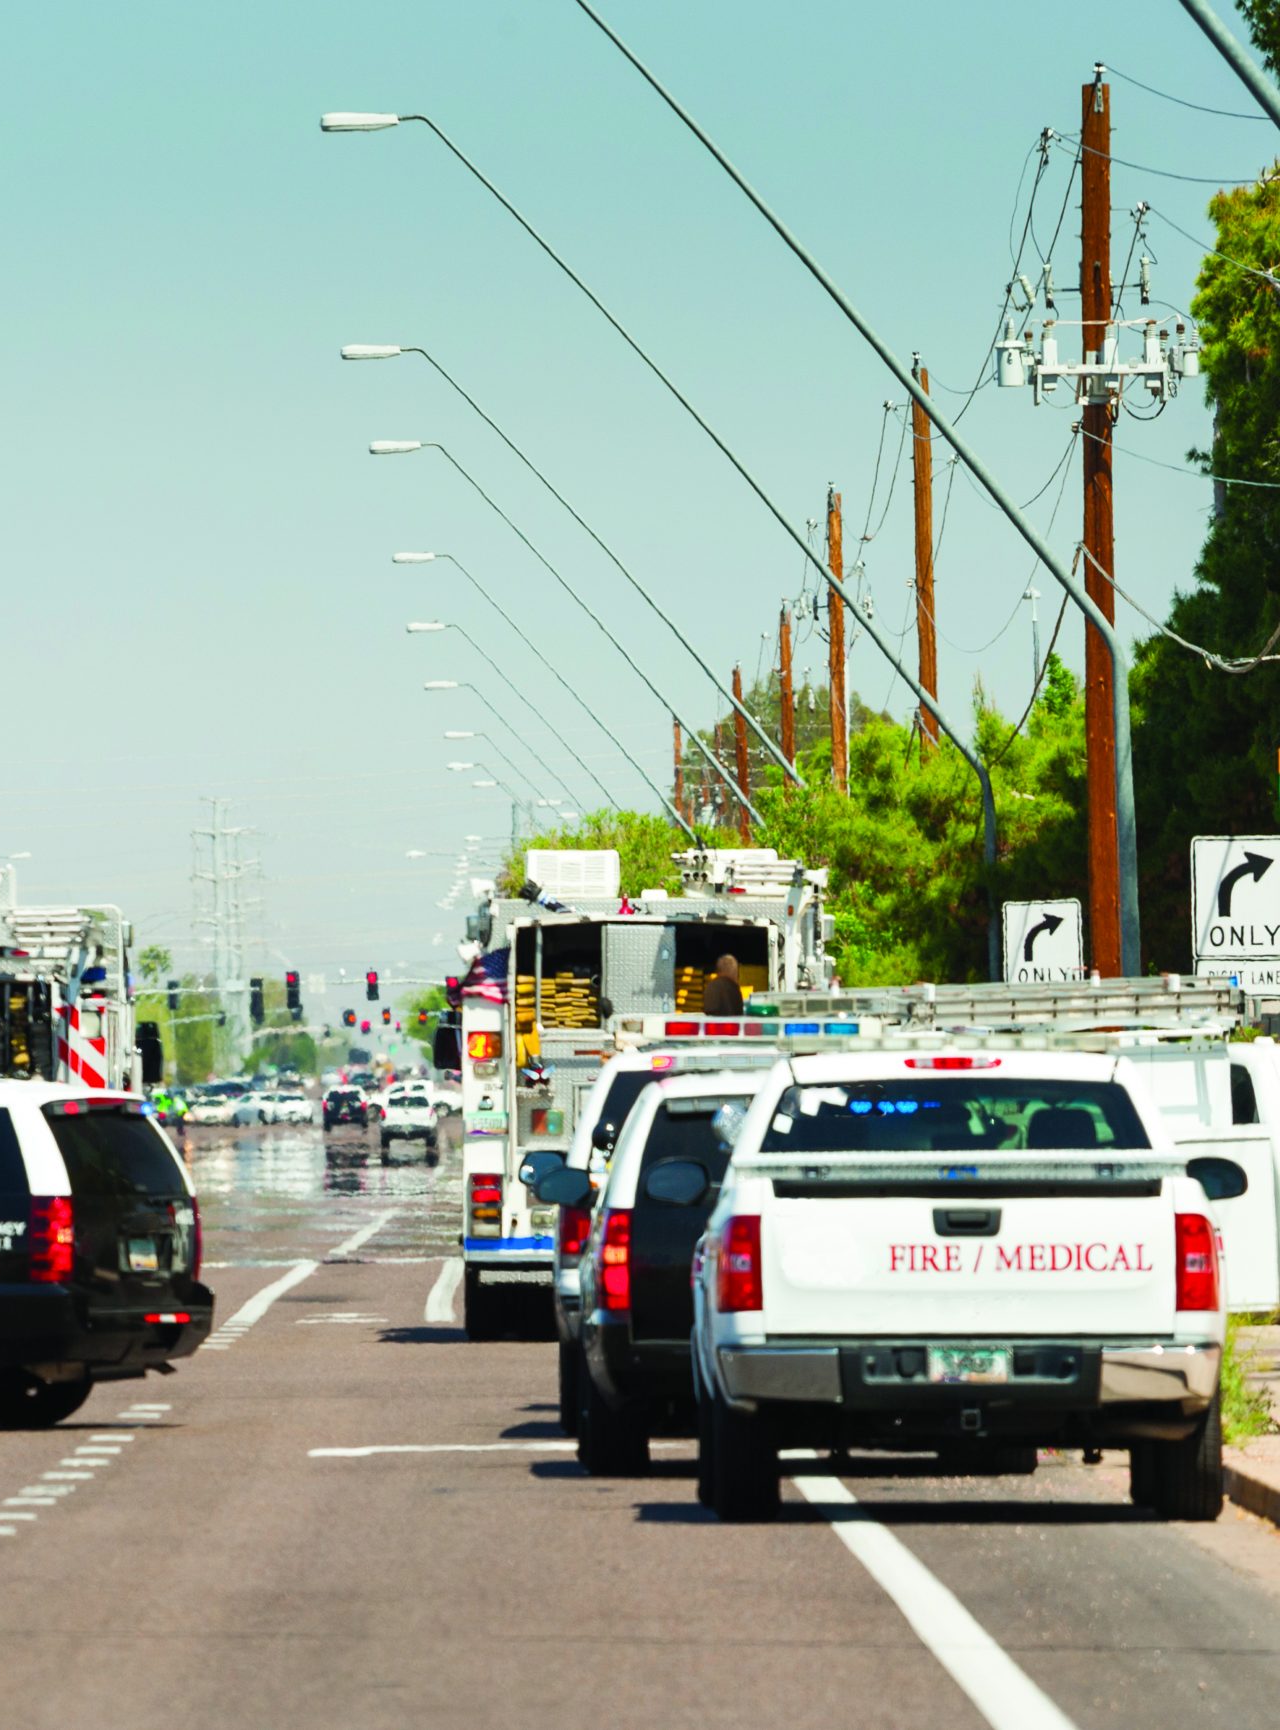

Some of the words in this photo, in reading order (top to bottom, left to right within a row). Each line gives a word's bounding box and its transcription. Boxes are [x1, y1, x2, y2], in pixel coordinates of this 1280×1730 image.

[1210, 925, 1280, 947] ONLY
[888, 1244, 962, 1272] FIRE
[995, 1242, 1154, 1272] MEDICAL
